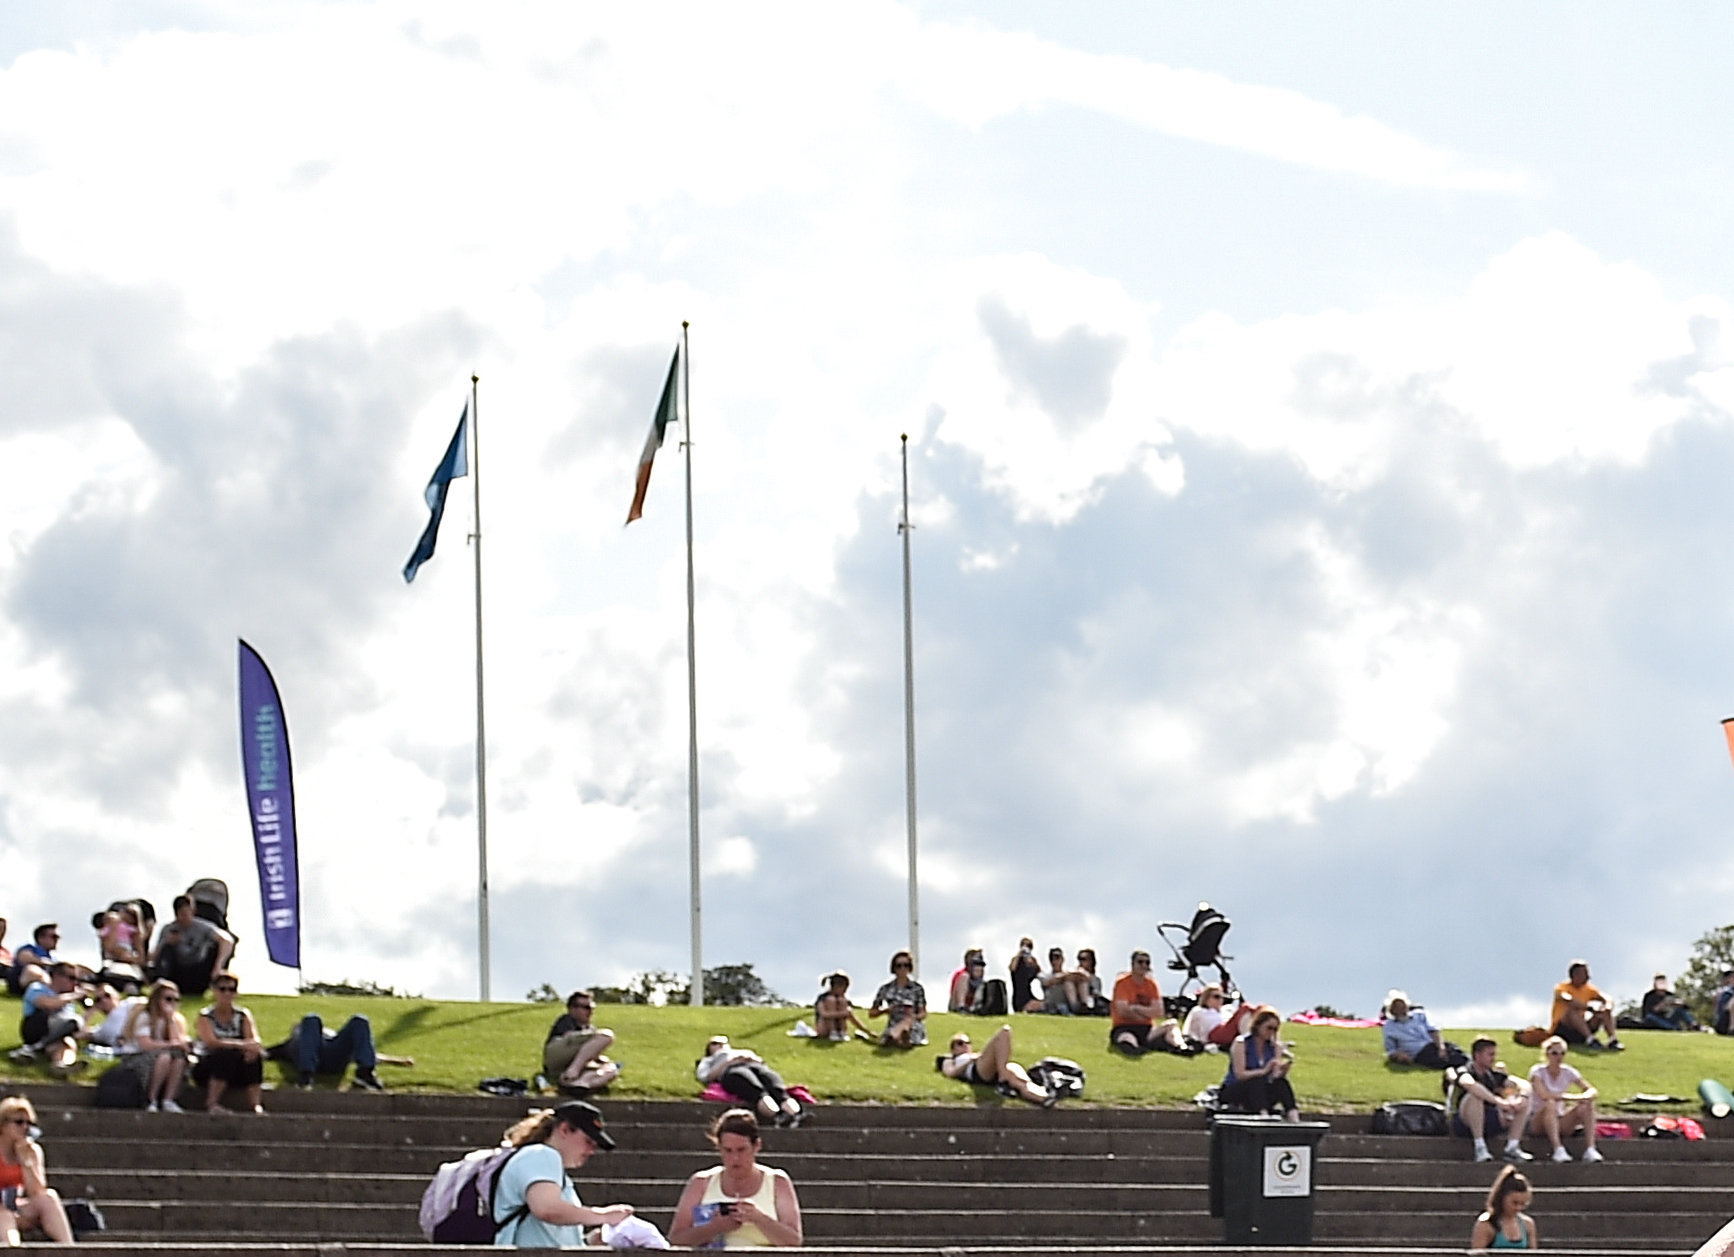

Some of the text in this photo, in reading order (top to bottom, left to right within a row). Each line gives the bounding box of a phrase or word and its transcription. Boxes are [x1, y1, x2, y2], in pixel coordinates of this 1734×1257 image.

[255, 705, 287, 899] Irish Life health
